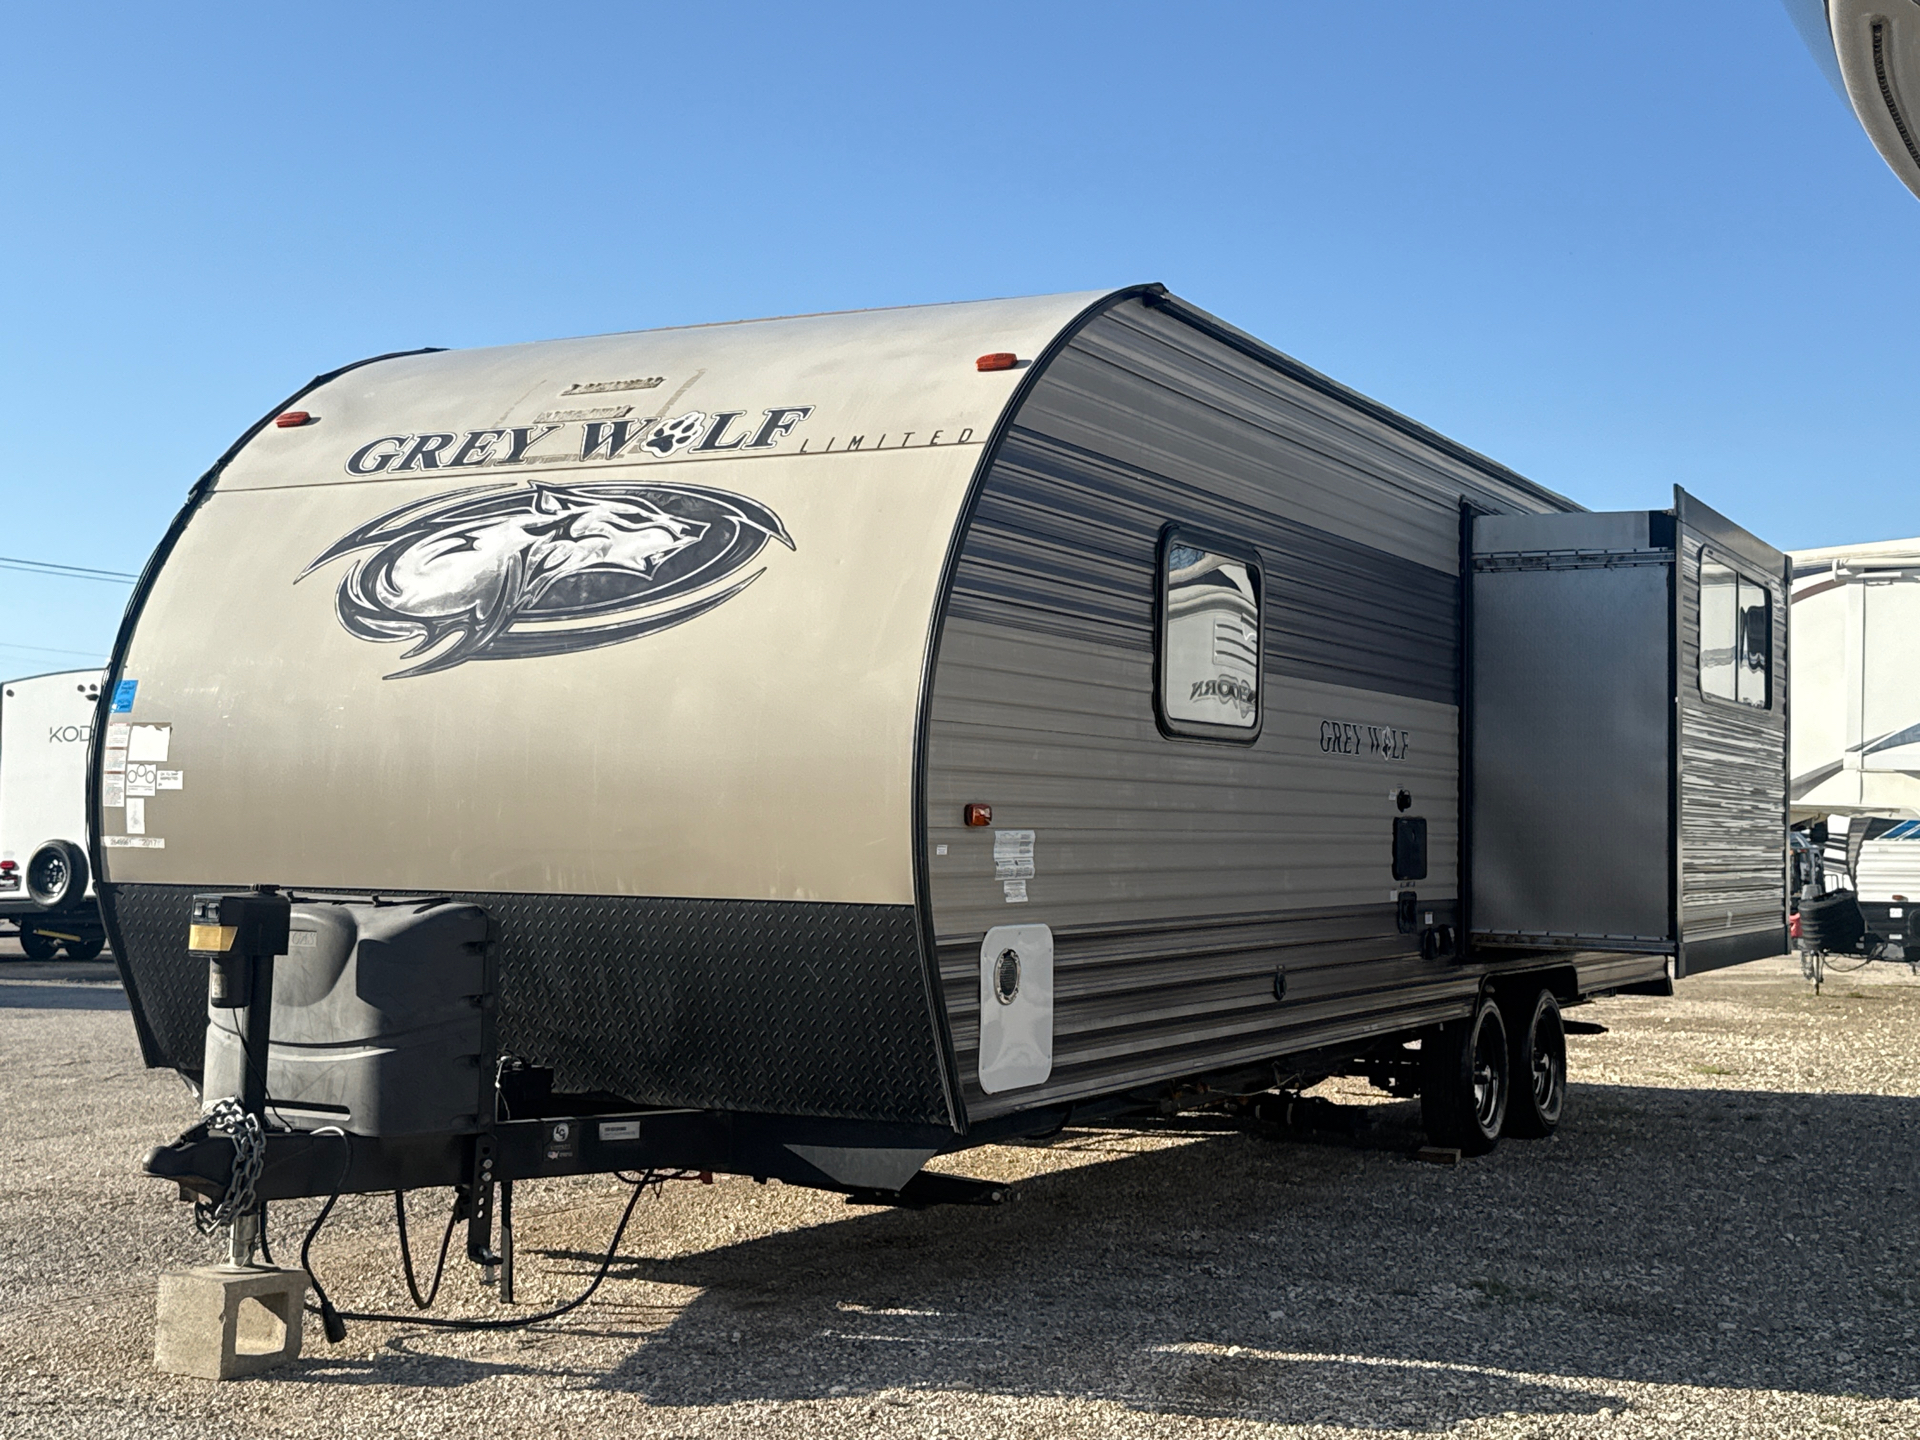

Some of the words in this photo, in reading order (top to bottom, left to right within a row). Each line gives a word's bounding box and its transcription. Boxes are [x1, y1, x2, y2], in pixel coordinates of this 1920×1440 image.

[345, 422, 565, 476] GREY
[800, 428, 974, 453] LIMITED
[1320, 719, 1363, 756] GREY
